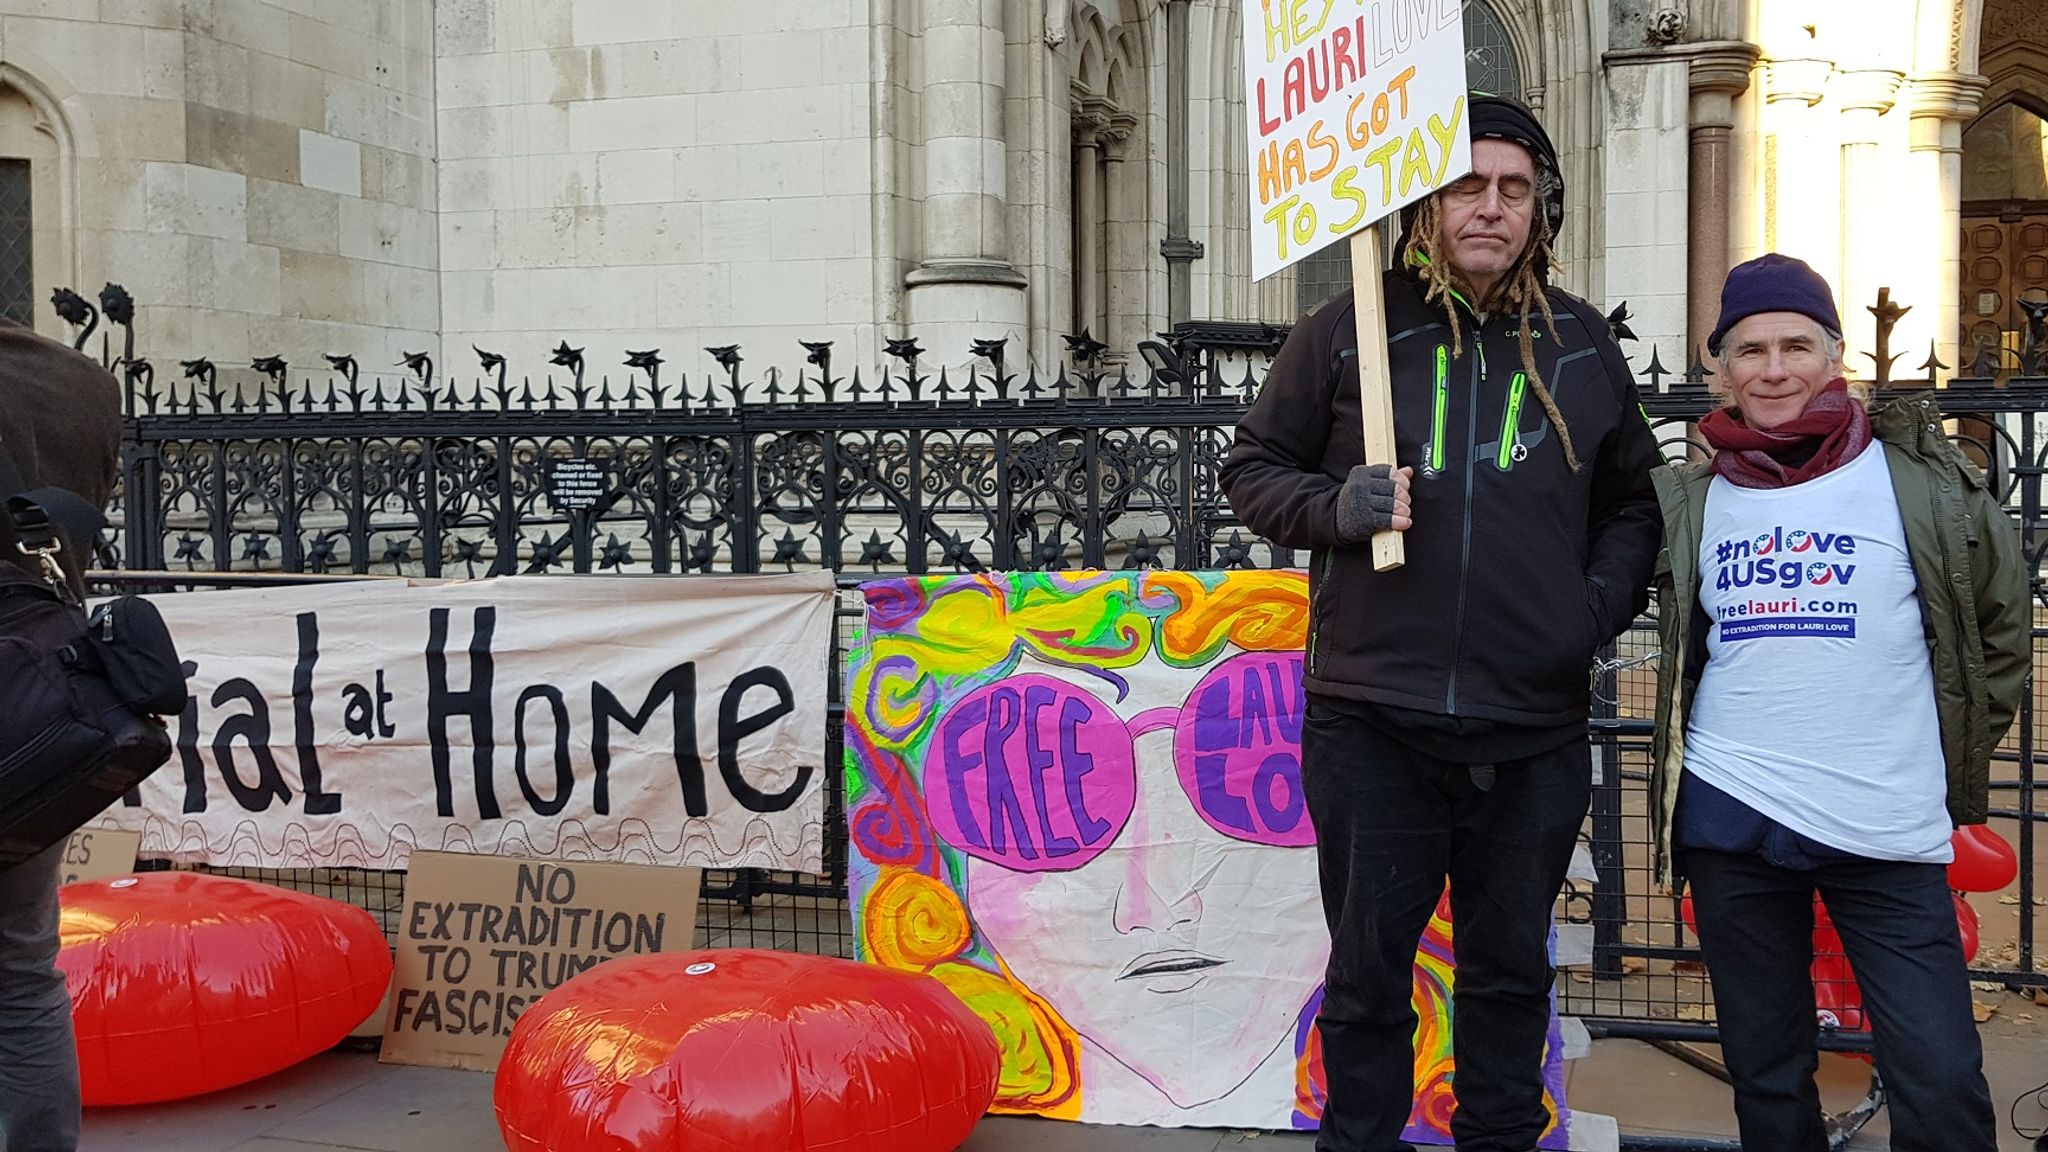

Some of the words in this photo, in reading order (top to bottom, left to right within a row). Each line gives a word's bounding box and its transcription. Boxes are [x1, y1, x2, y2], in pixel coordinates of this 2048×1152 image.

[1257, 15, 1367, 137] LAURI
[1371, 0, 1459, 68] LOVE
[1258, 120, 1340, 205] HAS
[1345, 65, 1416, 151] GOT
[1263, 194, 1317, 260] TO
[1329, 95, 1465, 234] STAY
[556, 463, 584, 471] Bicycles
[560, 497, 569, 505] by
[1716, 526, 1856, 564] #nolove
[1716, 558, 1856, 592] 4USgov
[1717, 598, 1858, 620] freelauri.com
[1798, 623, 1824, 631] LAURI
[1826, 624, 1850, 632] LOVE
[123, 612, 343, 815] iaL
[342, 669, 396, 740] at
[1194, 659, 1304, 752] LAU
[944, 686, 1111, 860] FREE
[1194, 752, 1304, 833] LO
[516, 864, 576, 904] NO
[408, 901, 666, 953] EXTRADITION
[418, 945, 471, 984] TO
[490, 949, 614, 989] TRUM
[393, 988, 543, 1037] FASCIS
